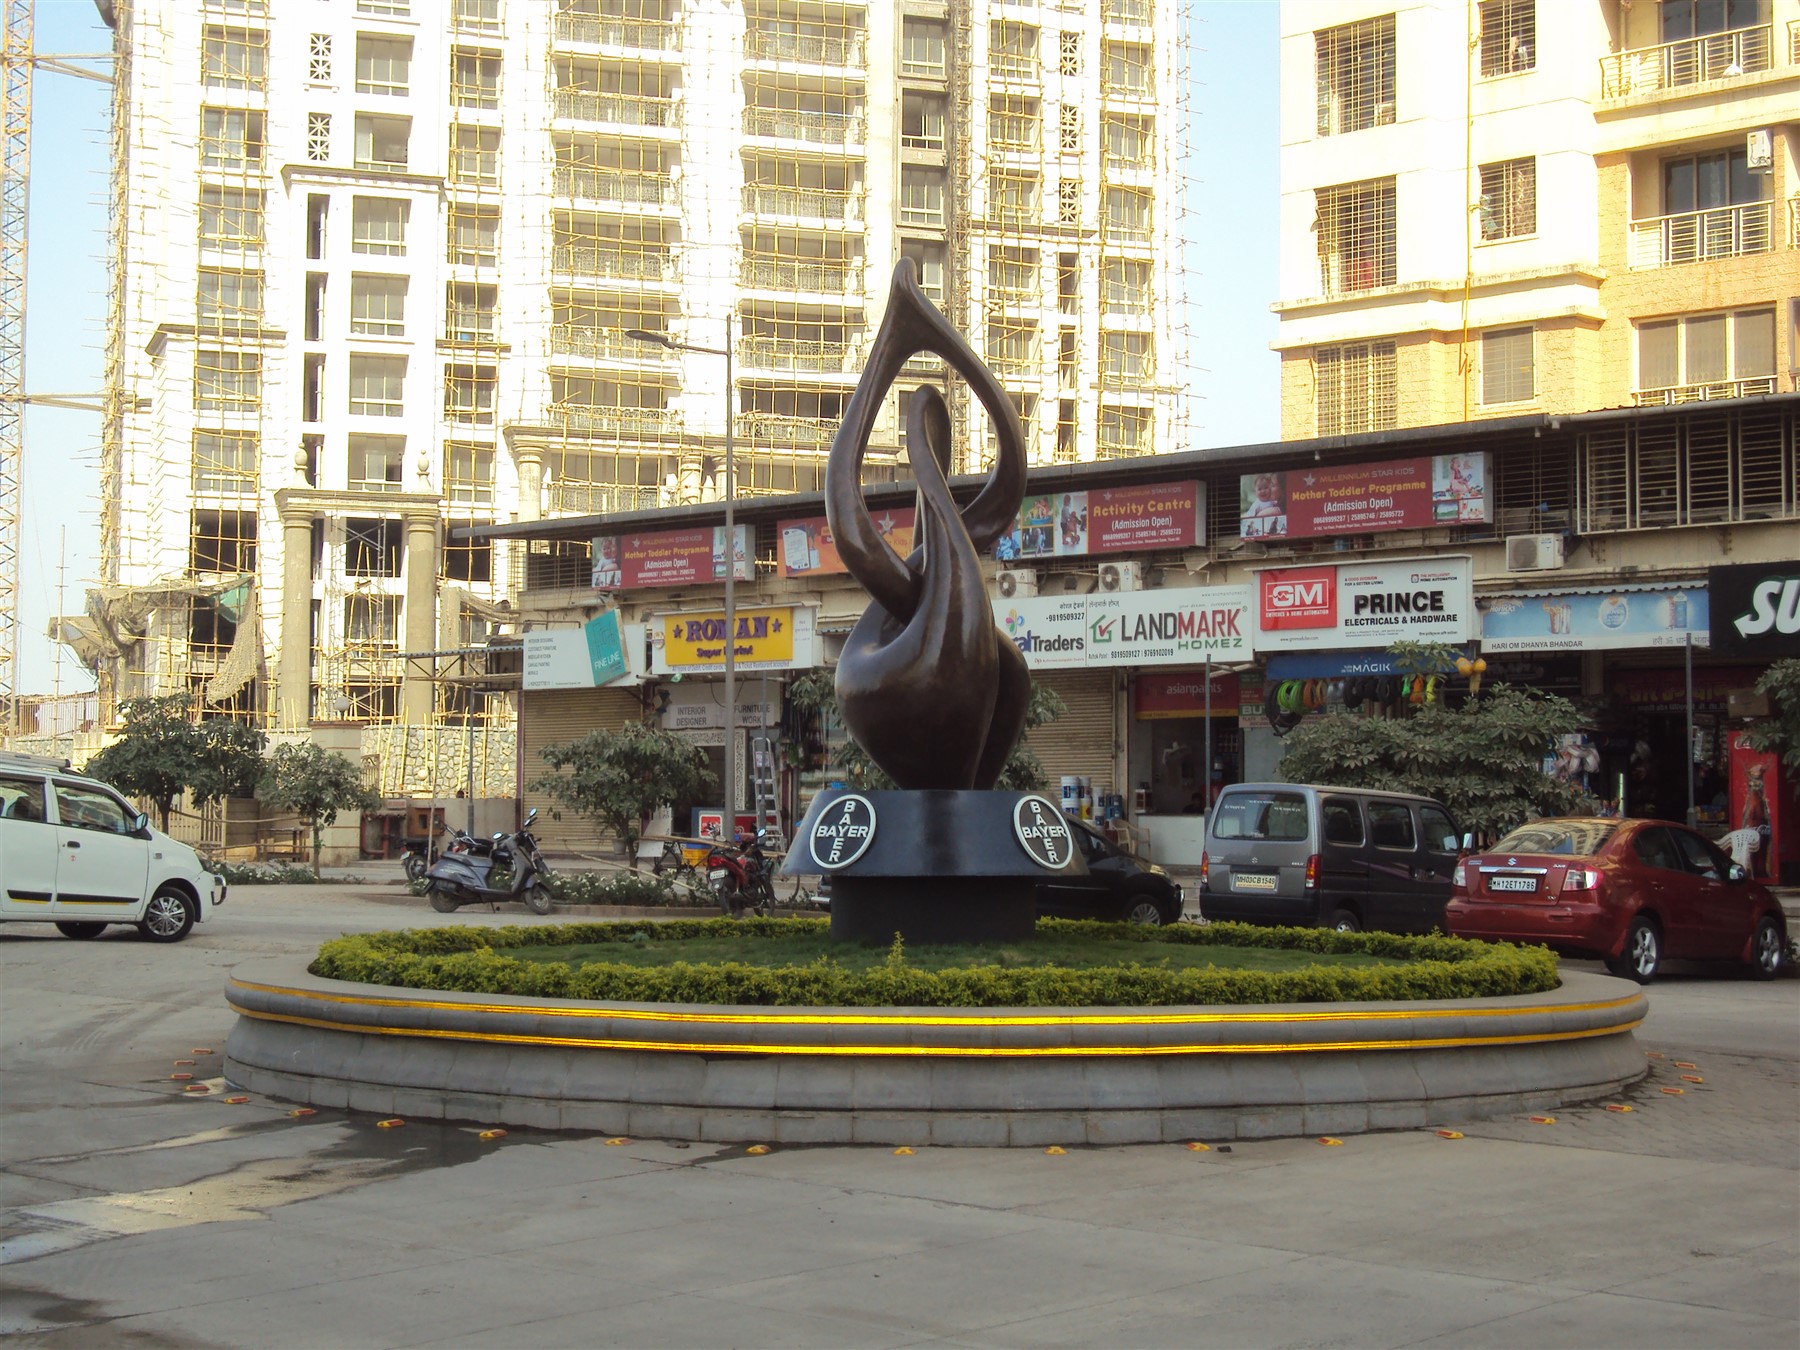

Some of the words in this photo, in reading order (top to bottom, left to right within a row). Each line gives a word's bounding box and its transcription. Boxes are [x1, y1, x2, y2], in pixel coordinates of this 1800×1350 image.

[1320, 472, 1369, 483] MILLENNIUM
[1371, 469, 1393, 478] STAR
[1394, 467, 1415, 476] KIDS
[1292, 490, 1326, 501] Mother
[1328, 487, 1365, 498] Toddler
[1368, 481, 1427, 495] Programme
[1093, 503, 1144, 517] Activity
[1147, 499, 1192, 512] Centre
[1323, 500, 1367, 514] (Admission
[1369, 497, 1393, 510] Open)
[1111, 518, 1149, 531] (Admission
[1151, 515, 1172, 527] Open)
[648, 549, 672, 558] Toddler
[673, 546, 710, 556] Programme
[644, 560, 672, 571] (Admission
[673, 558, 689, 568] Open)
[1271, 583, 1323, 607] GM
[1354, 590, 1445, 616] PRINCE
[1121, 608, 1241, 641] LANDMARK
[1344, 616, 1400, 626] ELECTRICALS
[1402, 616, 1408, 624] &
[1410, 614, 1458, 624] HARDWARE
[1178, 638, 1243, 650] HOMEZ
[696, 648, 722, 659] Super
[594, 656, 608, 671] FINE
[608, 651, 620, 665] LINE
[1352, 662, 1391, 672] MAGIK
[1166, 682, 1222, 696] asianpants
[678, 706, 706, 716] INTERIOR
[734, 704, 770, 713] FURNITUE
[1242, 705, 1265, 714] BU
[676, 717, 706, 726] DESIGNER
[742, 715, 762, 724] WORK
[816, 826, 868, 838] BAYER
[829, 801, 855, 862] BAYER
[1022, 826, 1067, 838] BAYER
[1030, 801, 1058, 862] BAYER
